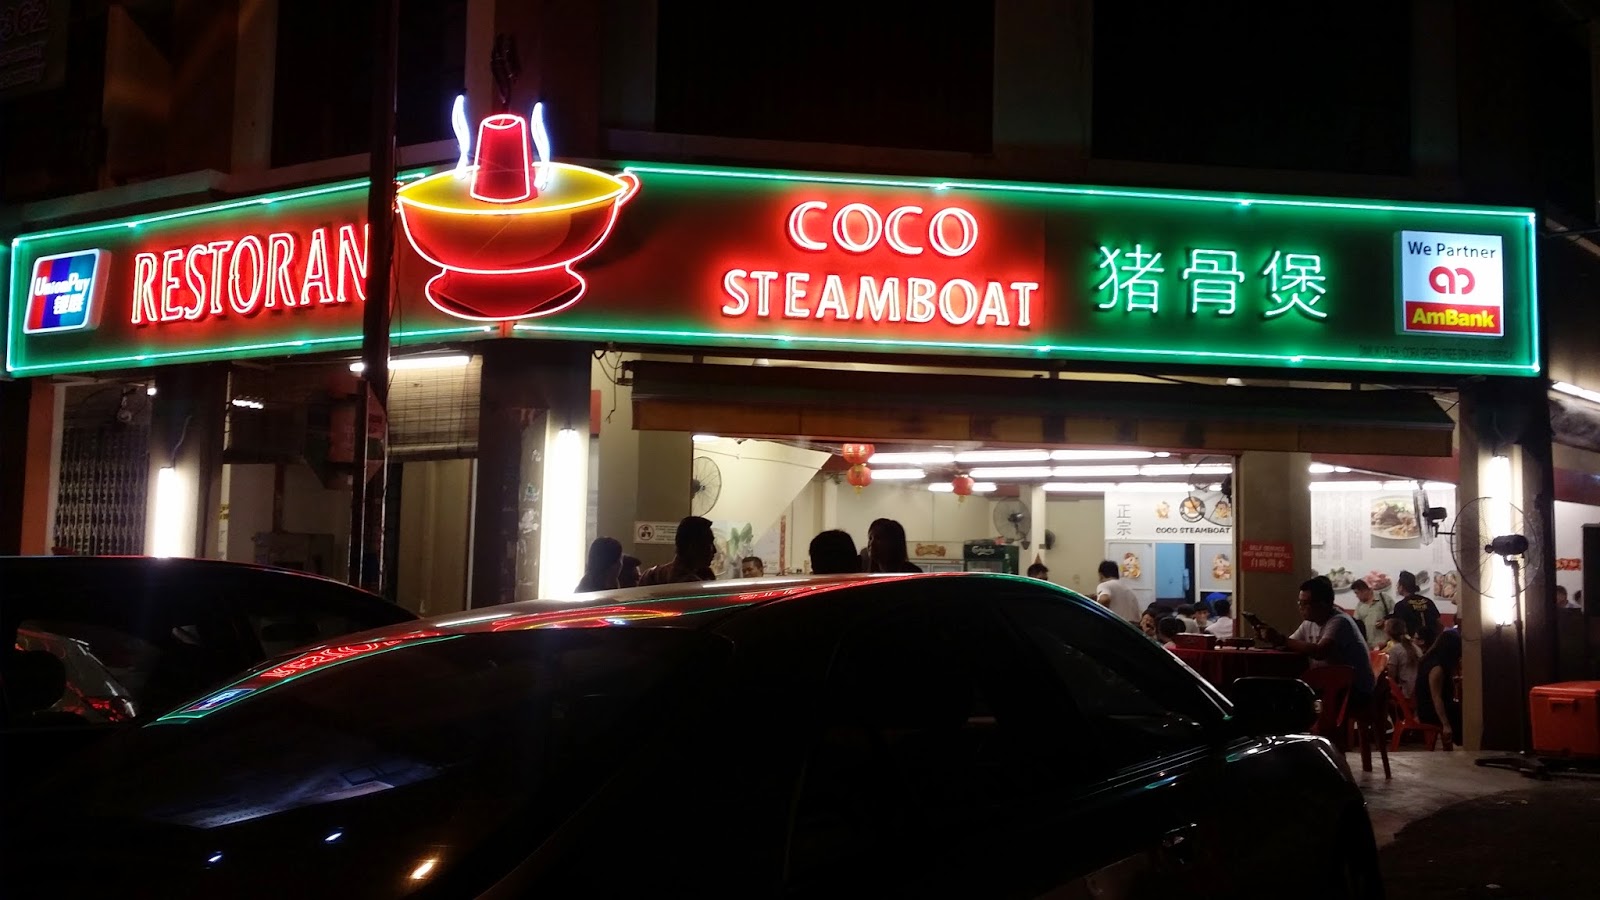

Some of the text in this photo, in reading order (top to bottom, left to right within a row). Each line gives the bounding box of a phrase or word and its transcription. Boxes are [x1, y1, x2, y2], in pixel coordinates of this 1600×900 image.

[788, 200, 979, 257] COCO
[1408, 241, 1497, 259] We Partner
[131, 223, 369, 325] RESTORAN
[722, 268, 1039, 327] STEAMBOAT
[1098, 244, 1327, 319] 猪骨煲
[1412, 307, 1496, 328] AmBank
